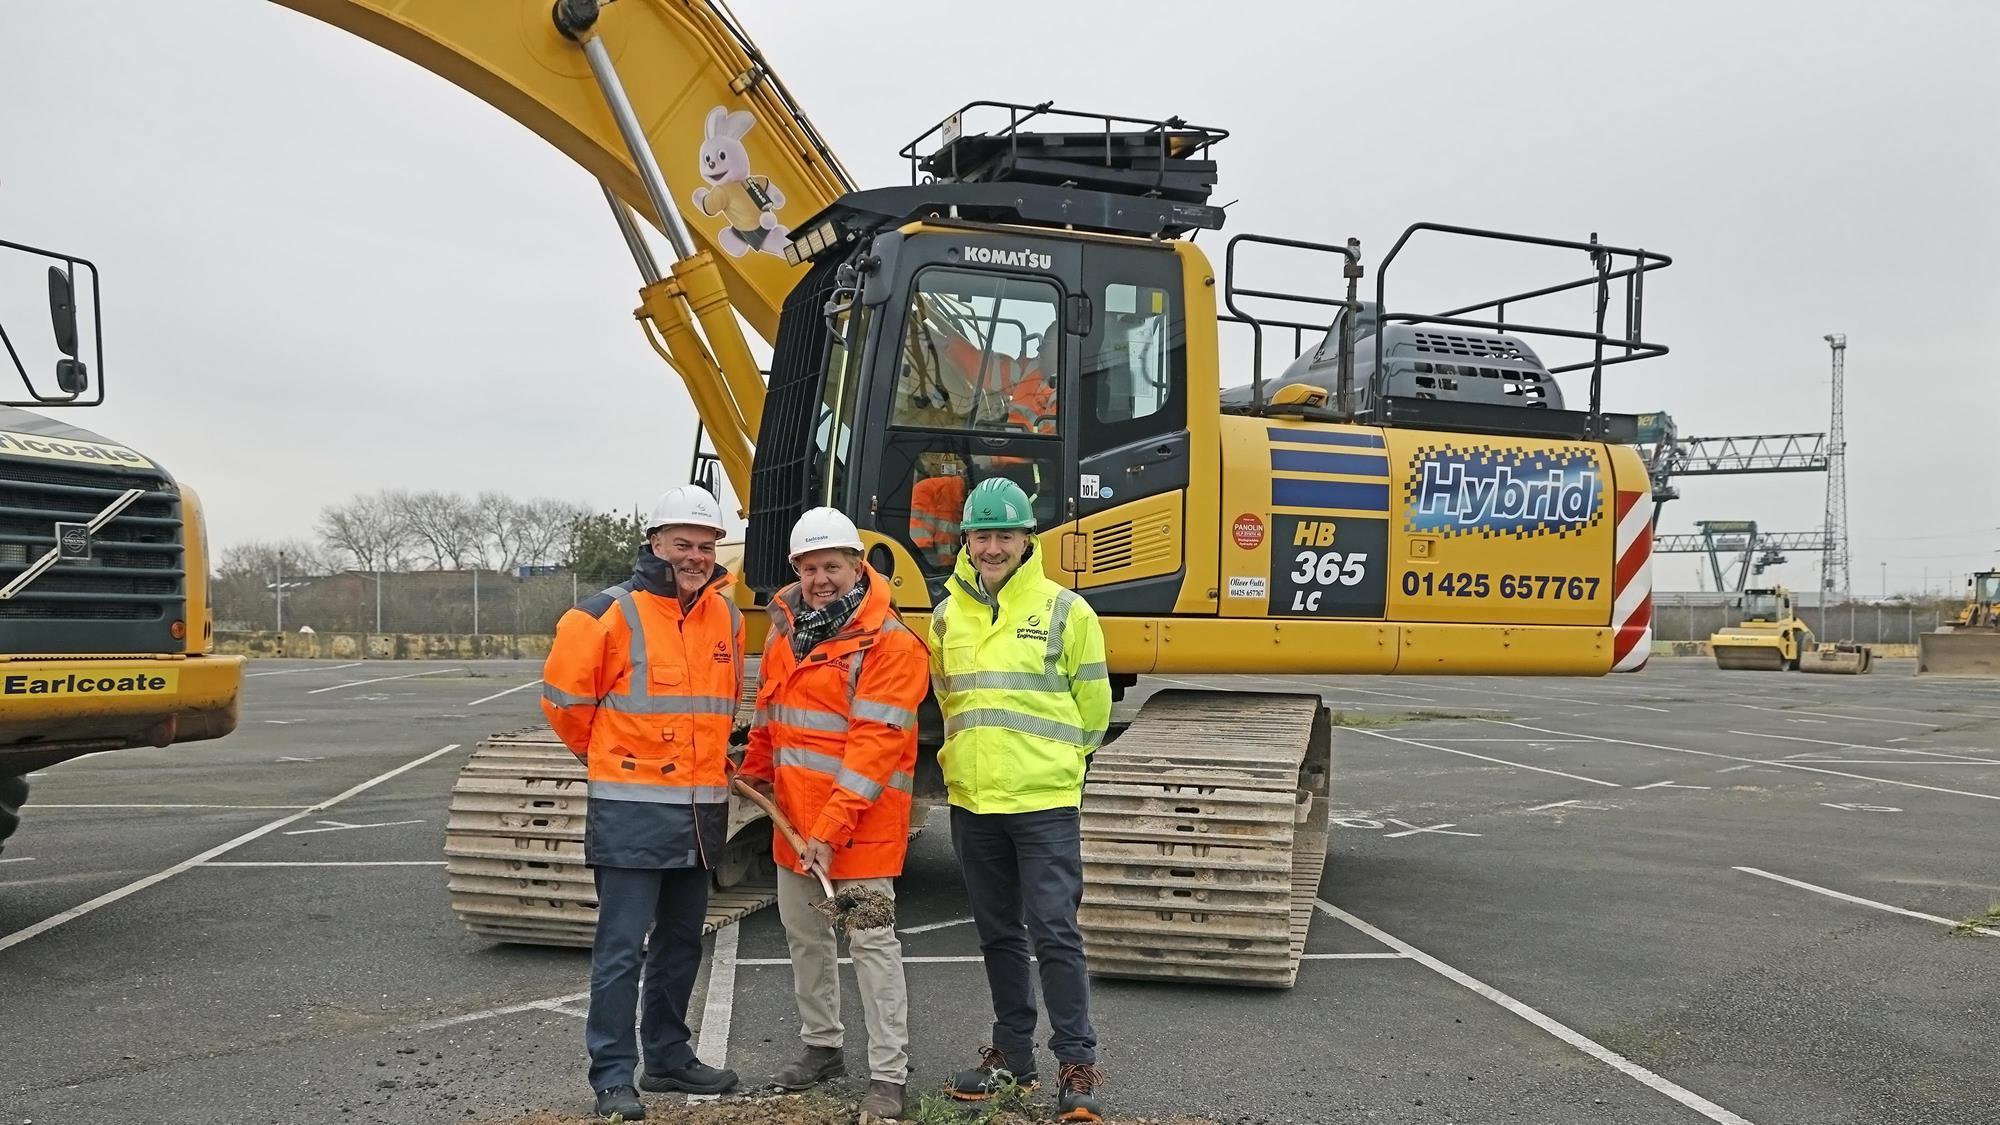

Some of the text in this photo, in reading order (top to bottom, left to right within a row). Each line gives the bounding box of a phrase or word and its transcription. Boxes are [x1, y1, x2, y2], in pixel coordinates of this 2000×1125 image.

[964, 246, 1052, 269] KOMATSU
[1082, 484, 1094, 497] 101
[1418, 461, 1595, 525] Hybrid
[1234, 523, 1264, 531] PANOLIN
[1293, 521, 1336, 547] HB
[1291, 550, 1368, 586] 365
[1230, 578, 1248, 587] Oliver
[1230, 589, 1264, 597] 01425 657767
[1402, 571, 1601, 601] 01425 657767
[1291, 590, 1322, 612] LC
[1016, 633, 1047, 642] Engineering
[4, 673, 167, 695] Earlcoate
